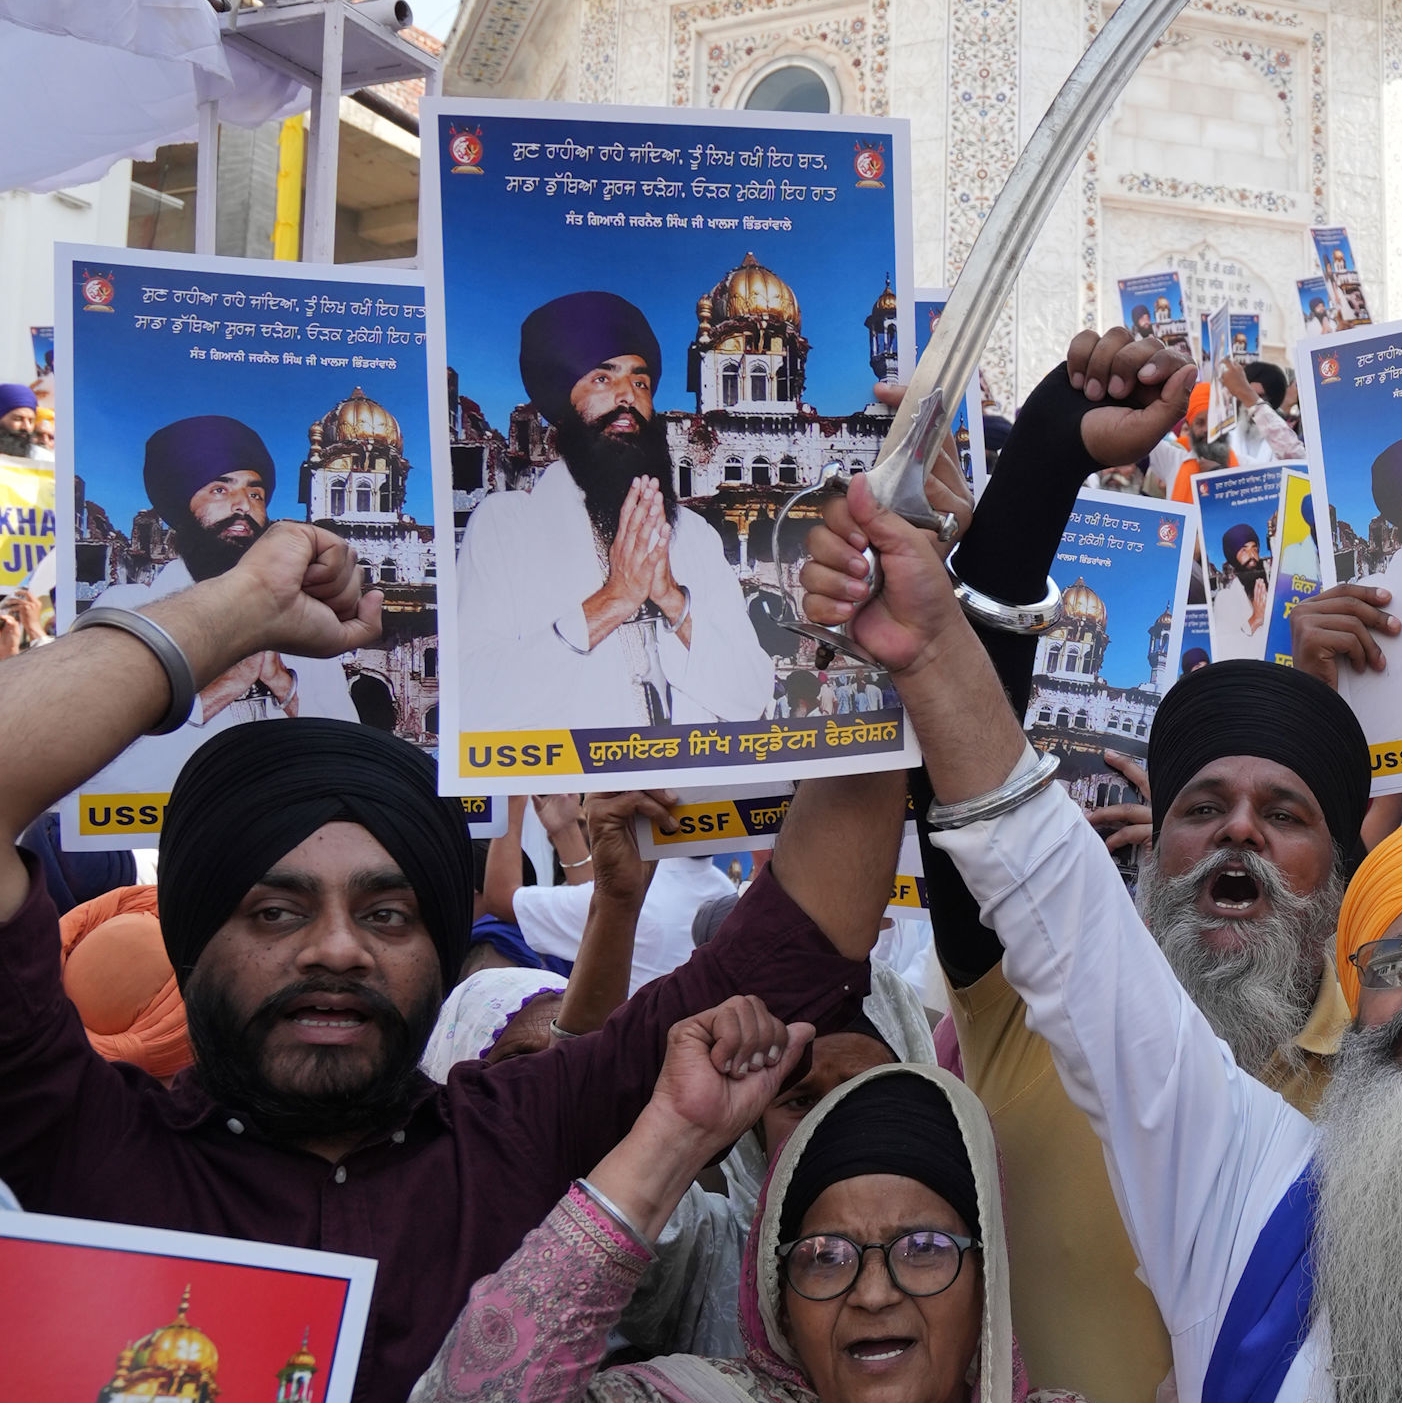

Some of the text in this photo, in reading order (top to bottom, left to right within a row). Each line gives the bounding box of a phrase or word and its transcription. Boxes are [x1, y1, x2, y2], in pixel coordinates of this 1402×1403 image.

[511, 142, 541, 161] ਸੁਣ
[544, 138, 595, 162] ਰਾਹੀਆ
[598, 142, 625, 161] ਰਾਹੇ
[688, 144, 703, 171] ਤੂੰ
[705, 144, 735, 167] ਲਿਖ
[738, 146, 764, 168] ਰਖੀਂ
[767, 146, 794, 168] ਇਹ
[504, 176, 540, 193] ਸਾਡਾ
[544, 172, 598, 196] ਡੁੱਬਿਆ
[601, 180, 637, 201] ਸੂਰਜ
[691, 177, 732, 199] ਓੜਕ
[735, 178, 777, 202] ਮੁਕੇਗੀ
[780, 178, 807, 201] ਇਹ
[810, 186, 838, 202] ਰਾਤ
[565, 210, 584, 226] ਸੰਤ
[587, 212, 626, 228] ਗਿਆਨੀ
[629, 212, 663, 228] ਜਰਨੈਲ
[666, 213, 688, 229] ਸਿੰਘ
[691, 214, 704, 229] ਜੀ
[141, 286, 168, 303] ਸੁਣ
[171, 286, 218, 308] ਰਾਹੀਆ
[222, 291, 247, 308] ਰਾਹੇ
[304, 295, 318, 317] ਤੂੰ
[320, 295, 346, 315] ਲਿਖ
[375, 299, 400, 317] ਇਹ
[134, 314, 168, 330] ਸਾਡਾ
[171, 313, 220, 336] ਡੁੱਬਿਆ
[224, 321, 257, 341] ਸੂਰਜ
[305, 323, 343, 341] ਓੜਕ
[346, 326, 383, 345] ਮੁਕੇਗੀ
[387, 326, 411, 345] ਇਹ
[468, 743, 565, 770] USSF
[588, 733, 680, 767] ਯੁਨਾਇਟਡ
[688, 729, 732, 757] ਸਿੱਖ
[738, 724, 819, 762] ਸਟੂਡੈਂਟਸ
